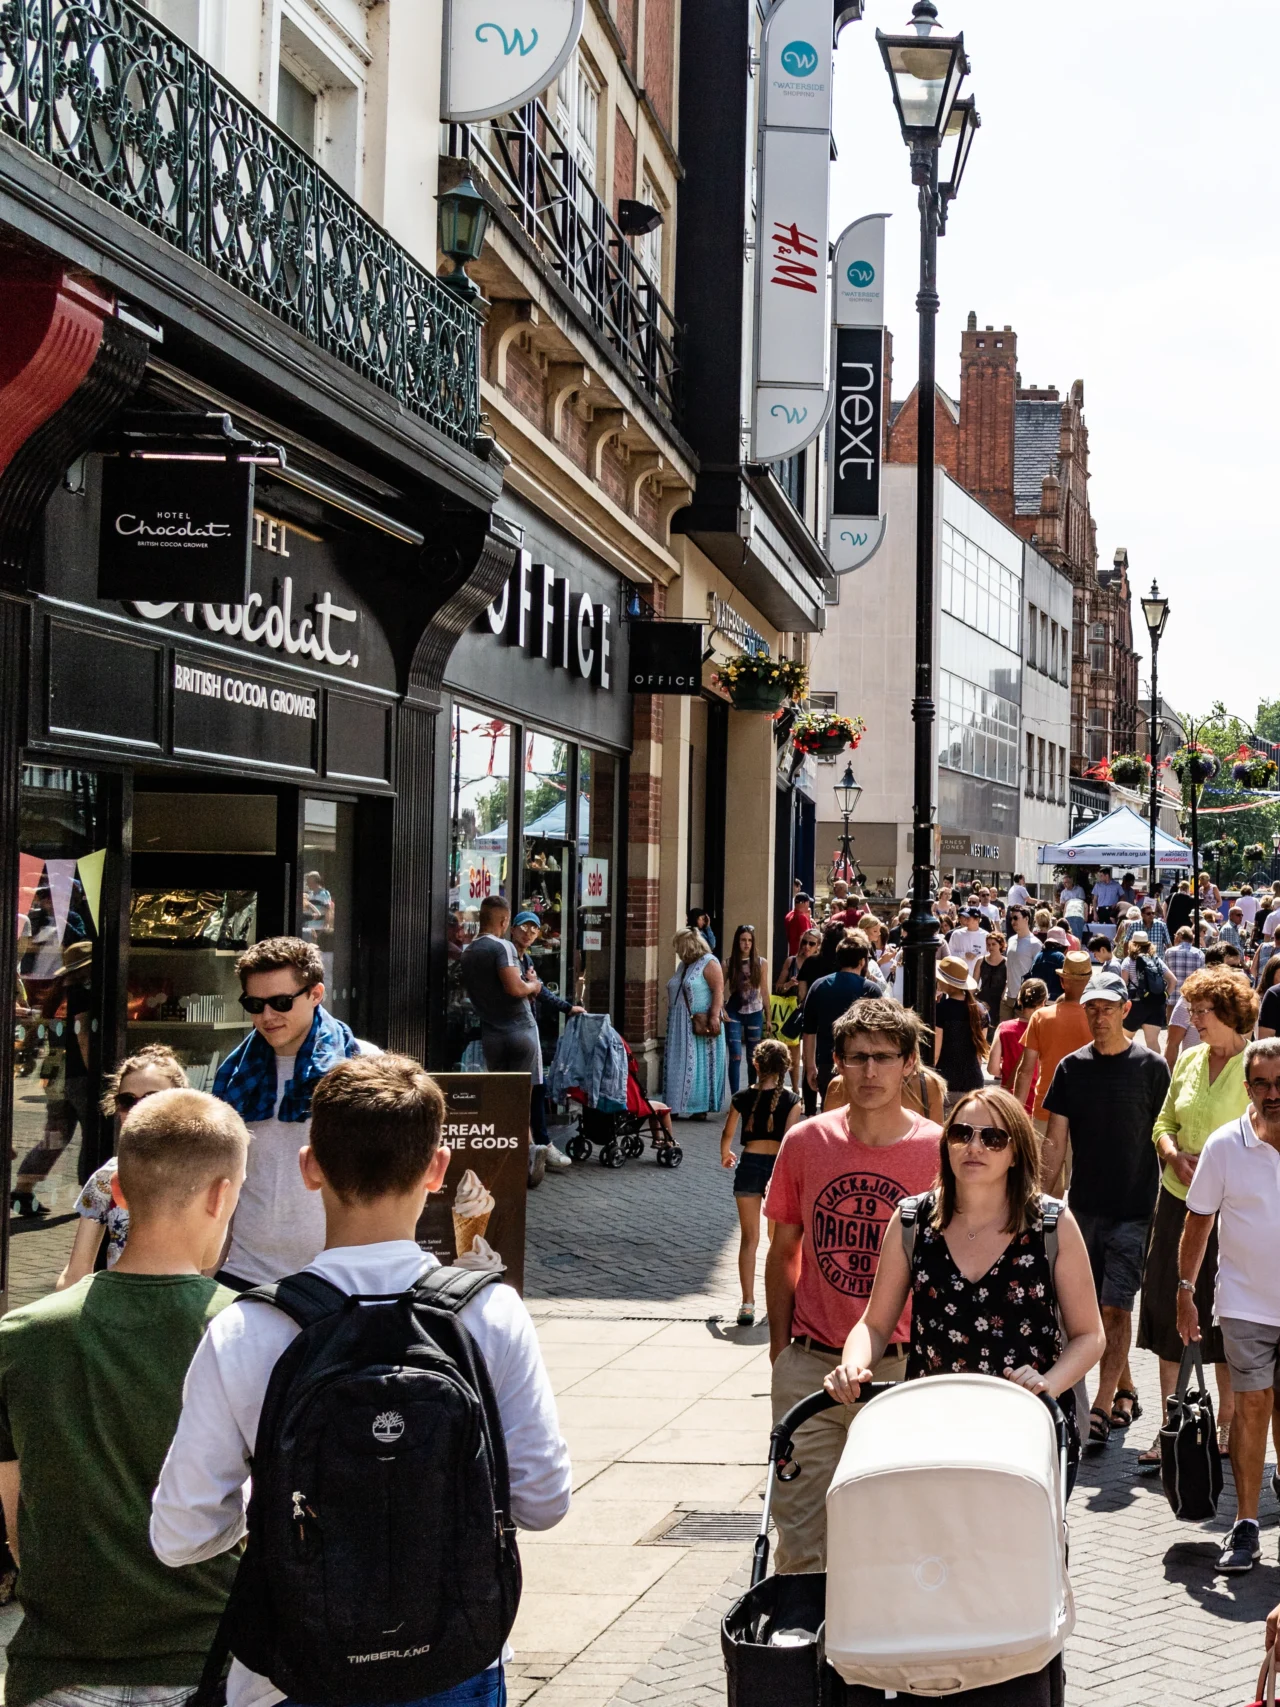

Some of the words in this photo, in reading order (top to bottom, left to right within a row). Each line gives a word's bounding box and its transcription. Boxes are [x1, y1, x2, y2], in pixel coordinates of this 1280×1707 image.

[773, 81, 825, 91] WATERSIDE
[783, 90, 815, 98] SHOPPING
[770, 221, 819, 294] H&M
[838, 361, 875, 481] next
[157, 511, 190, 520] HOTEL
[254, 514, 290, 558] TEL
[131, 576, 359, 668] ocolat.
[174, 664, 221, 699] BRITISH
[223, 678, 268, 710] COCOA
[270, 689, 317, 720] GROWER
[634, 674, 695, 687] OFFICE
[469, 857, 491, 899] sale
[587, 863, 603, 896] sale
[470, 1137, 519, 1149] GODS
[826, 1177, 906, 1206] JACK&JON
[853, 1197, 877, 1216] 19
[815, 1210, 881, 1252] ORIGIN
[820, 1256, 875, 1294] CLOTHI
[848, 1253, 872, 1273] 90
[347, 1643, 431, 1664] TIMBERLAND
